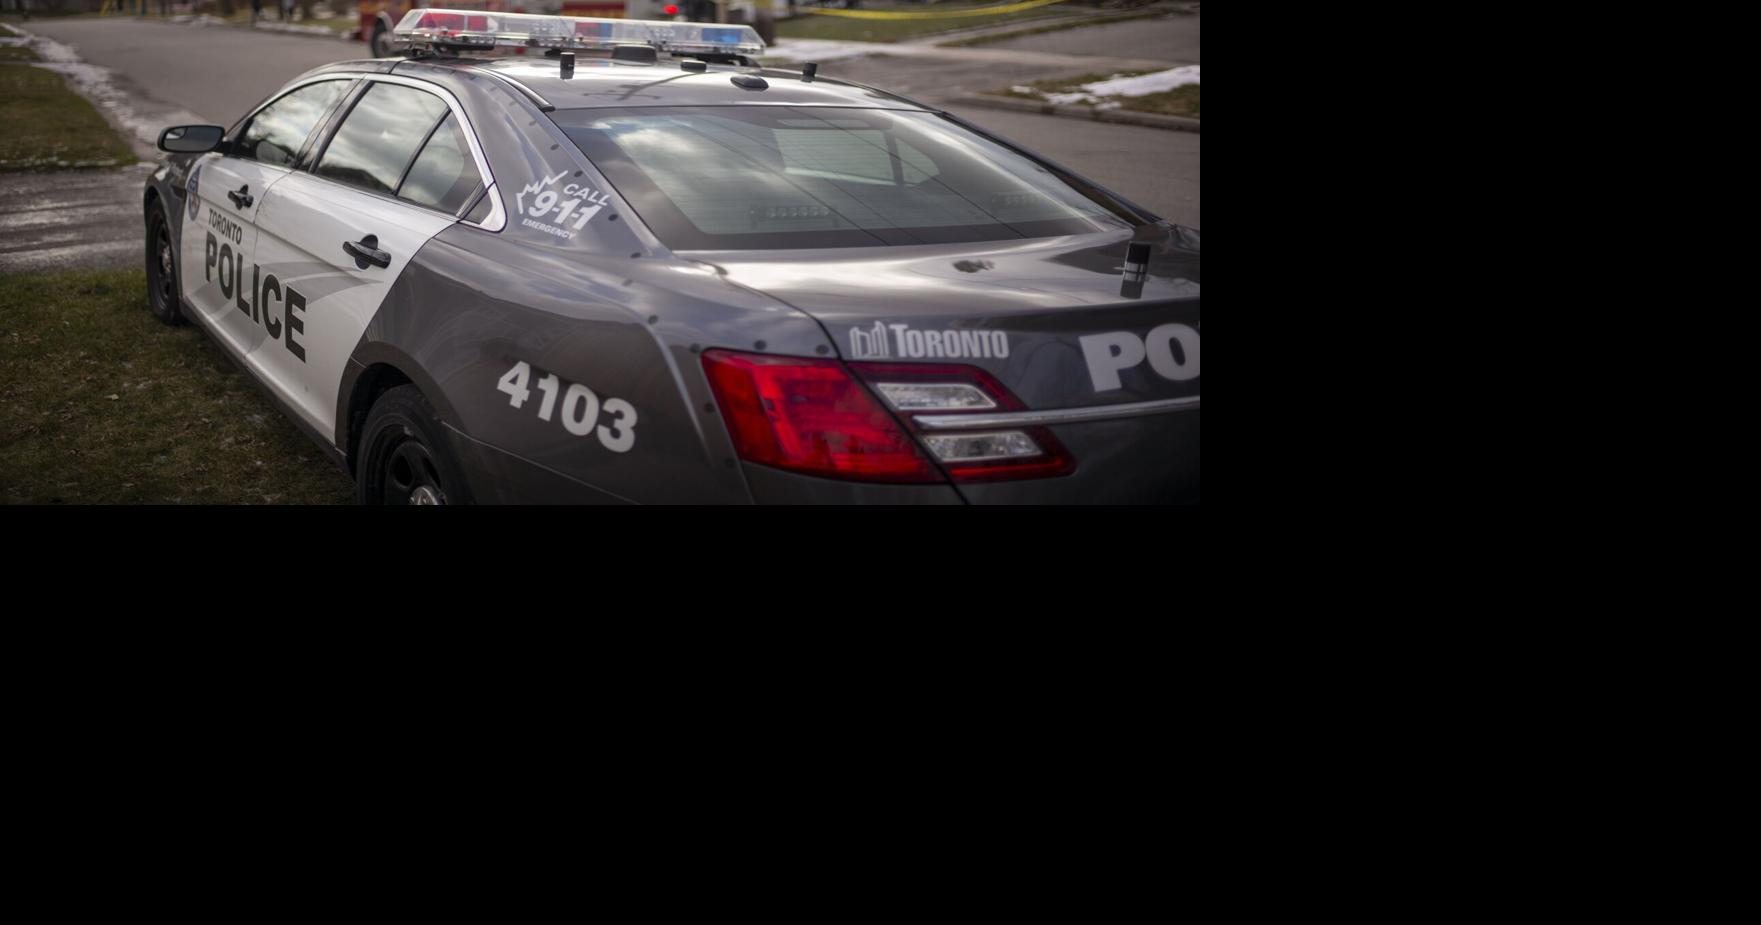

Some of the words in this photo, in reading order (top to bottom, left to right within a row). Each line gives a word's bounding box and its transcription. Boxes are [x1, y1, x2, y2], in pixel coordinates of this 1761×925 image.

[528, 190, 602, 230] 9-1-1
[563, 183, 610, 206] CALL
[208, 208, 243, 245] TORONTO
[521, 218, 576, 240] EMERGENCY
[206, 231, 307, 363] POLICE
[889, 323, 1009, 359] TORONTO
[496, 360, 638, 453] 4103
